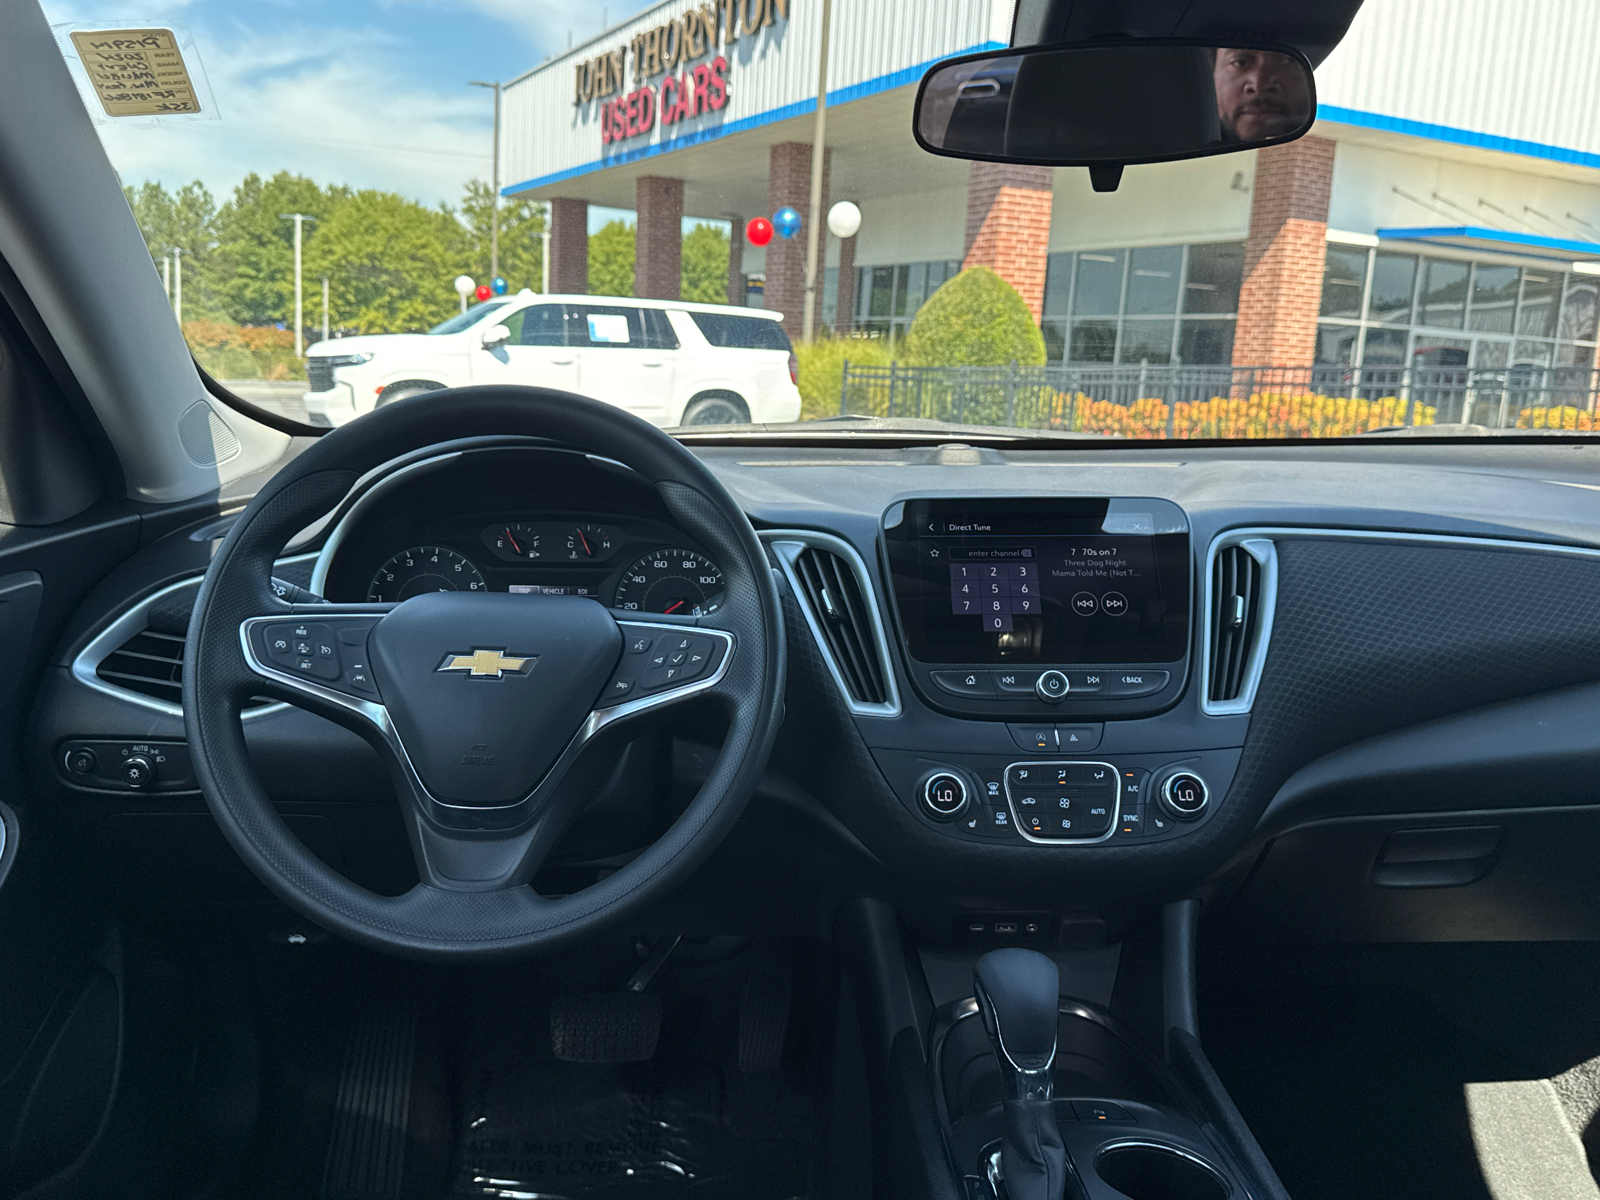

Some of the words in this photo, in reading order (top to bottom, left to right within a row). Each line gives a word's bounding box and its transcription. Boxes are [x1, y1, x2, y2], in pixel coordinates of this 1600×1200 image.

[574, 46, 627, 106] JOHN
[601, 86, 655, 145] USED
[661, 56, 727, 125] CARS
[949, 523, 972, 532] Direct
[973, 523, 991, 532] Tune
[497, 540, 503, 548] E
[533, 540, 540, 548] F
[990, 549, 1020, 557] channel
[1070, 548, 1076, 556] 7
[1082, 548, 1097, 556] 70s
[1111, 548, 1117, 556] 7
[406, 559, 414, 567] 3
[430, 555, 438, 563] 4
[1064, 559, 1086, 567] Three
[1088, 559, 1103, 568] Dog
[1105, 559, 1127, 568] Night
[454, 564, 462, 572] 5
[654, 560, 668, 568] 60
[682, 560, 696, 569] 80
[961, 567, 967, 577] 1
[990, 567, 997, 577] 2
[1020, 567, 1027, 577] 3
[1052, 569, 1075, 577] Mama
[1076, 569, 1093, 577] Told
[1095, 569, 1107, 577] Me
[1109, 569, 1128, 578] (Not
[386, 574, 394, 582] 2
[632, 575, 646, 583] 40
[699, 576, 716, 584] 100
[470, 582, 478, 590] 6
[962, 584, 969, 593] 4
[991, 584, 998, 593] 5
[1021, 584, 1028, 593] 6
[624, 602, 638, 610] 20
[963, 601, 970, 610] 7
[993, 601, 1000, 610] 8
[1022, 601, 1029, 610] 9
[994, 618, 1002, 628] 0
[1126, 676, 1143, 684] BACK
[461, 754, 496, 767] AIRBAG
[1127, 784, 1139, 793] A/C
[937, 789, 953, 802] LO
[1178, 789, 1194, 802] LO
[1090, 807, 1106, 815] AUTO
[1123, 814, 1139, 822] SYNC
